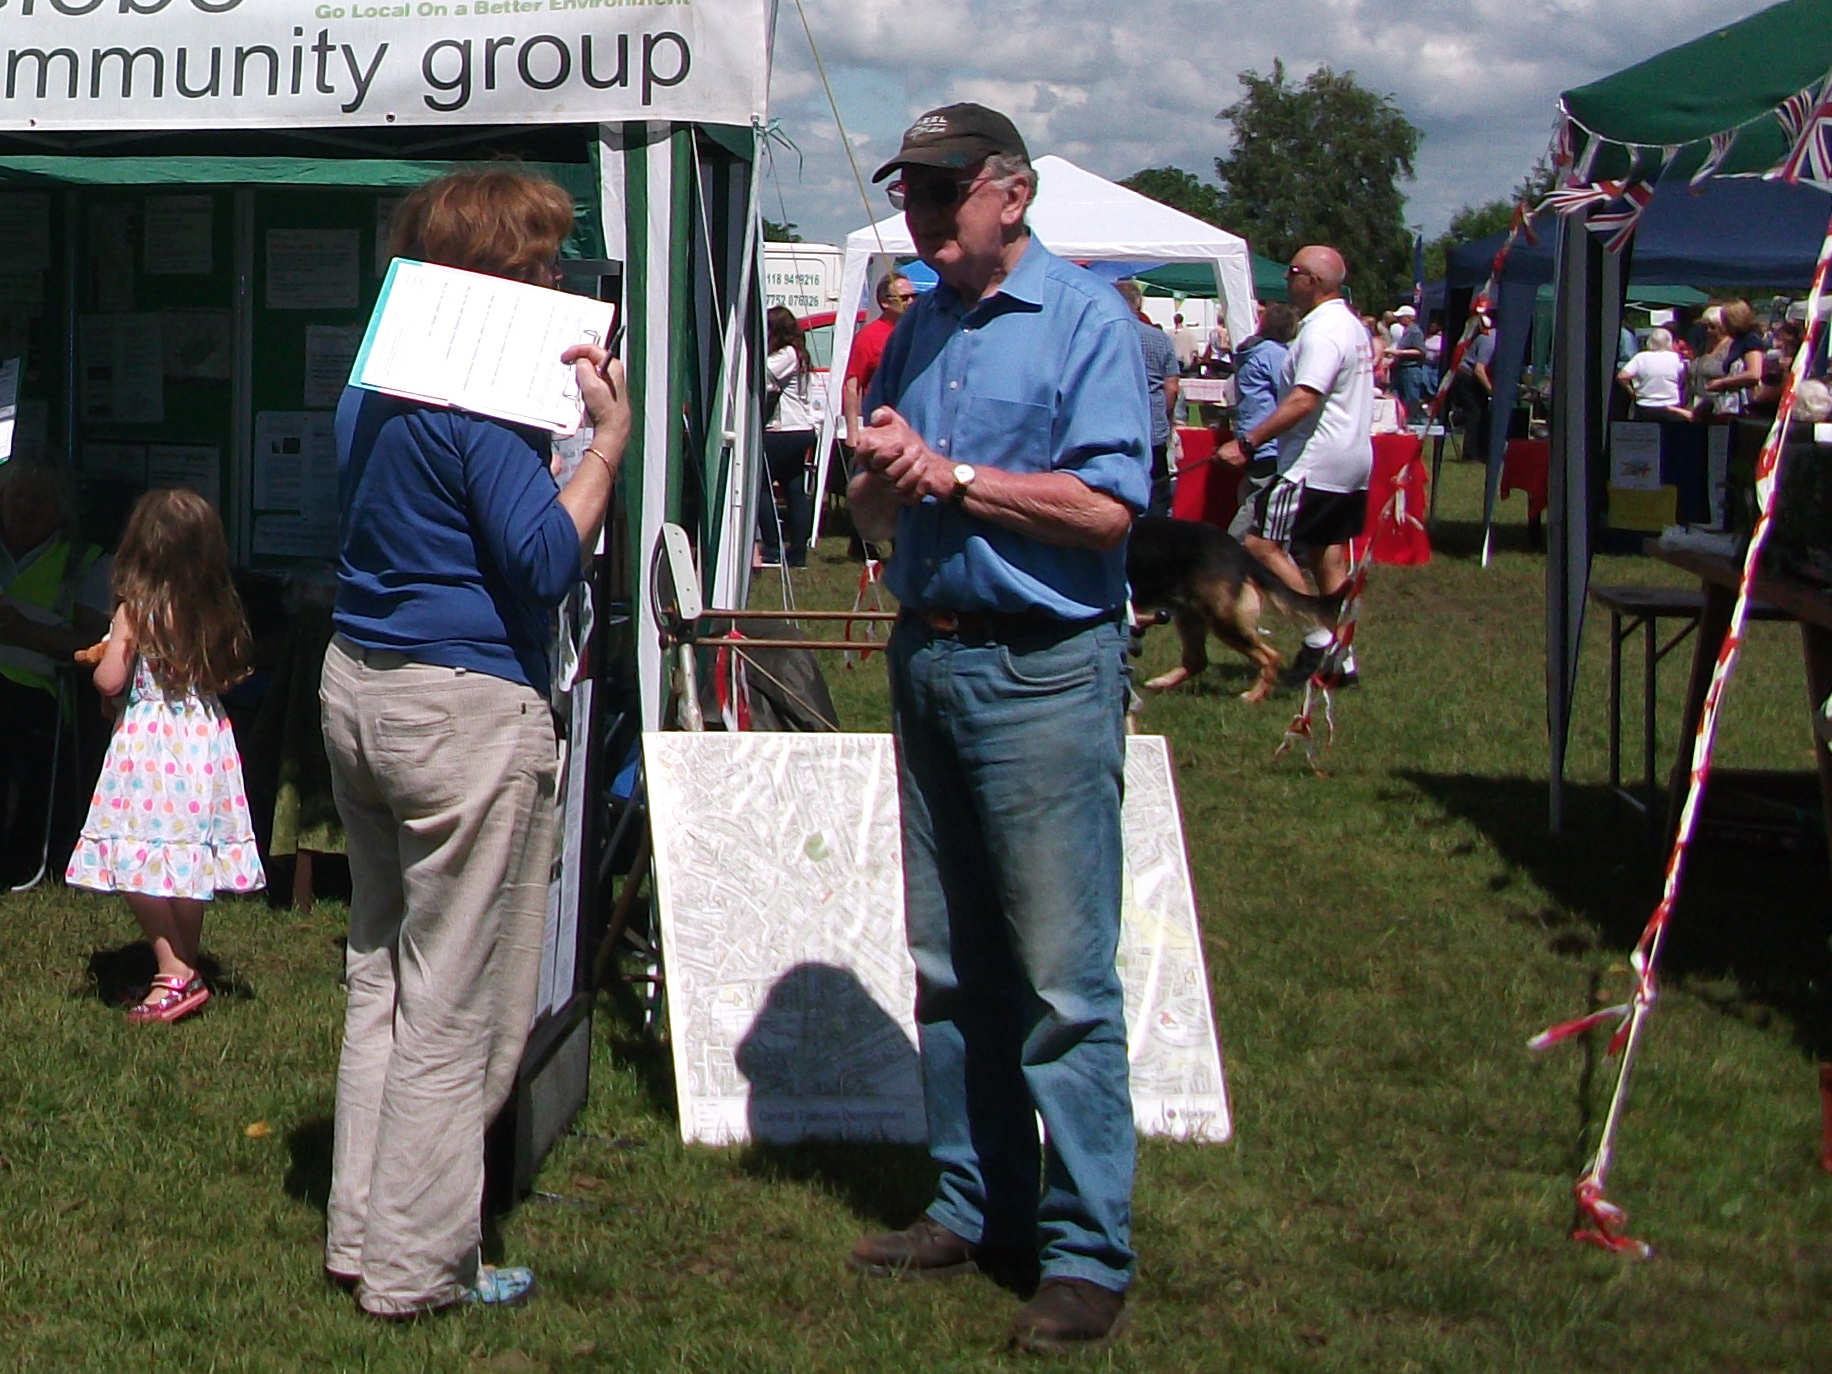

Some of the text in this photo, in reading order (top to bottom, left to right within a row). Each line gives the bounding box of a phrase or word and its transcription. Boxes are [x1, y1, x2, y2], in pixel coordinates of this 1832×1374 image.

[315, 4, 345, 20] Go
[352, 2, 410, 18] Local
[417, 1, 448, 17] On
[454, 4, 468, 16] a
[421, 28, 692, 113] group
